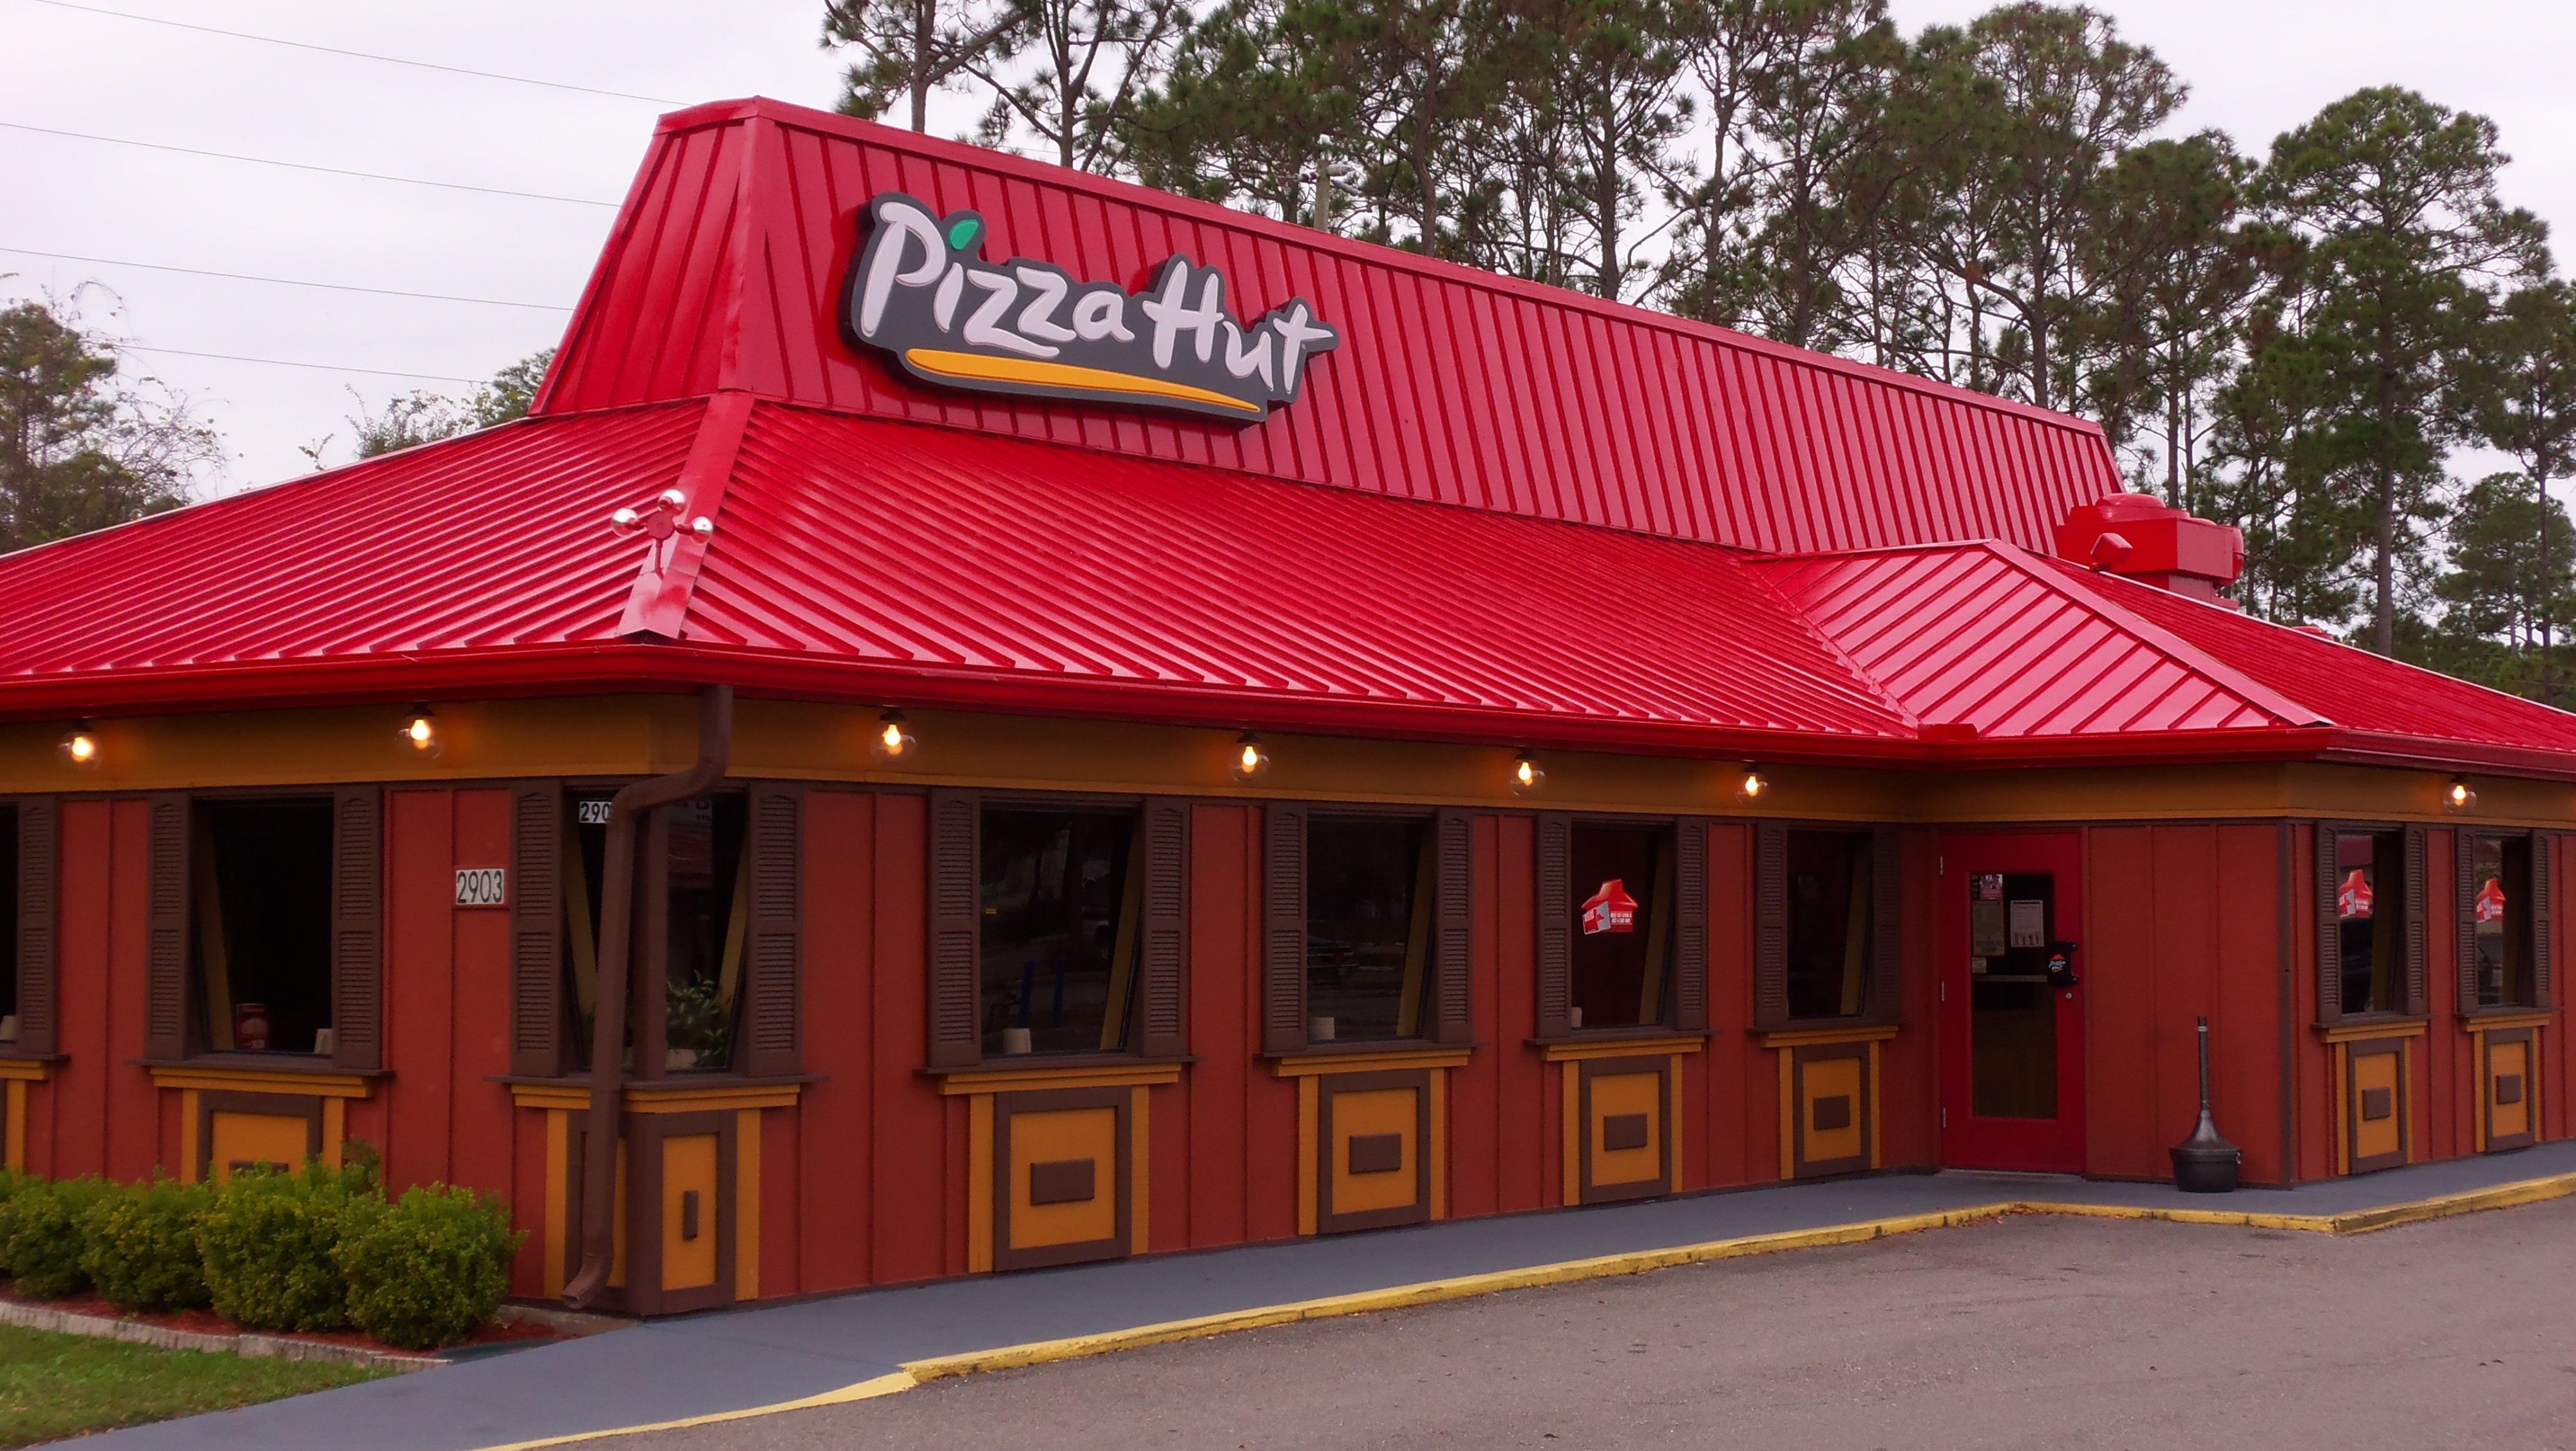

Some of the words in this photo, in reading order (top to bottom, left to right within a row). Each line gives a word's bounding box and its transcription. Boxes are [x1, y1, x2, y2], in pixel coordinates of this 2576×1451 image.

[862, 202, 1135, 358] Pizza
[1142, 260, 1334, 394] Hut
[581, 802, 611, 822] 290
[457, 871, 503, 903] 2903
